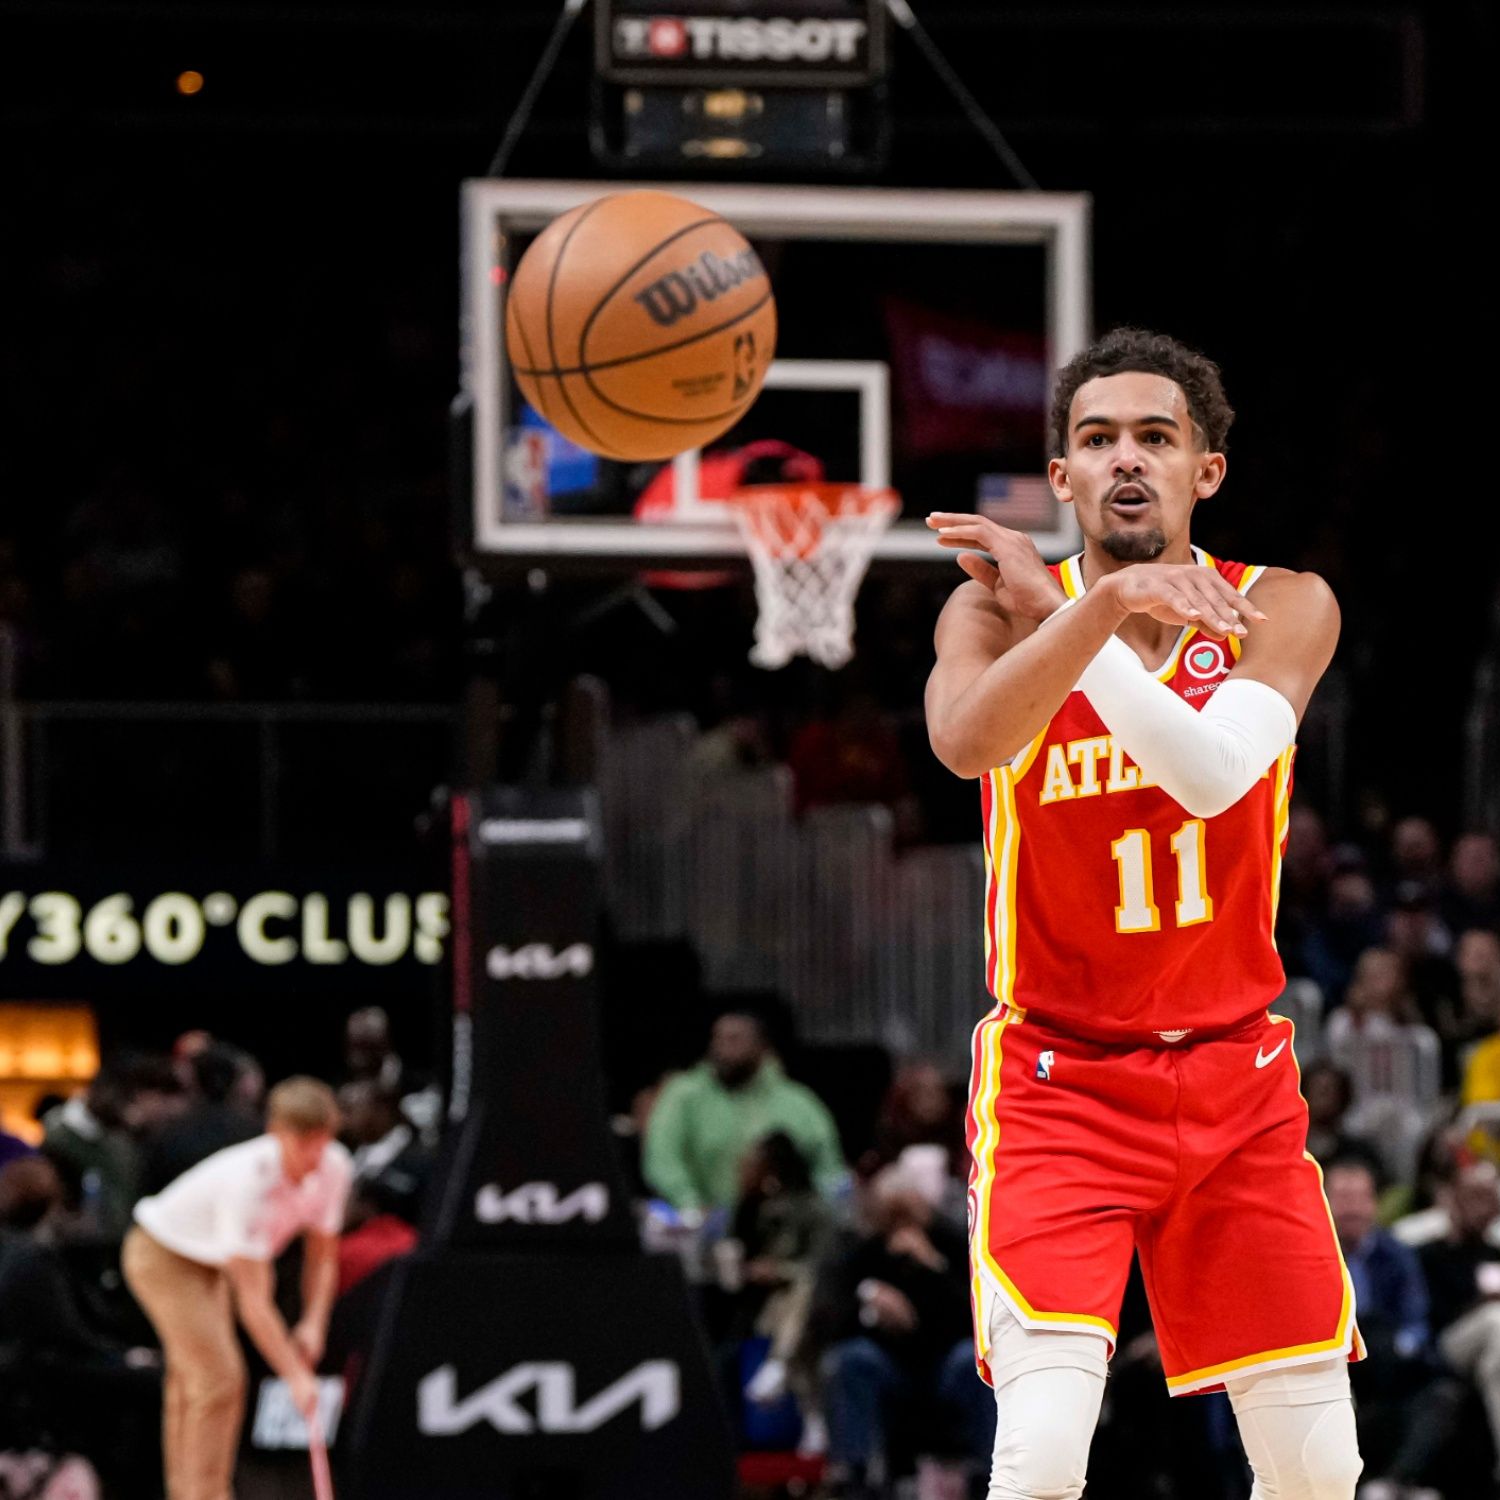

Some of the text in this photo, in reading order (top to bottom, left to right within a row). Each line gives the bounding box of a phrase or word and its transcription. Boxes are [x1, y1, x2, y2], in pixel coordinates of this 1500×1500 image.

[687, 17, 866, 60] TISSOT
[634, 250, 766, 327] Wilso
[1039, 734, 1158, 806] ATL
[1111, 818, 1213, 933] 11
[416, 1359, 681, 1435] KIA
